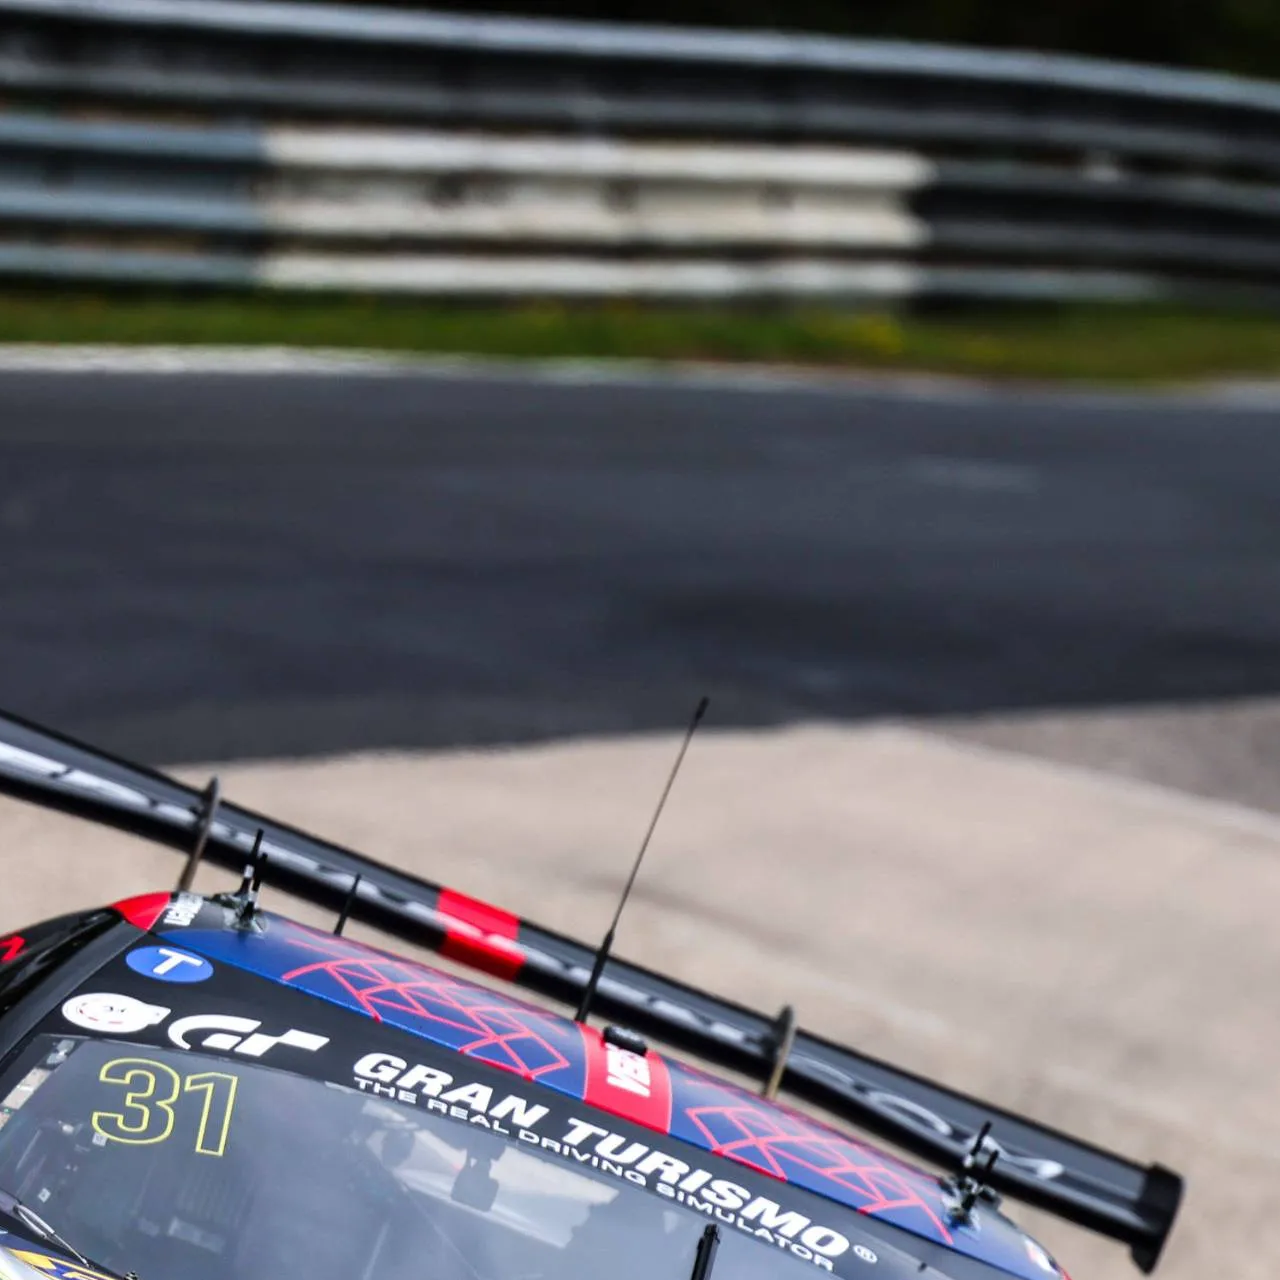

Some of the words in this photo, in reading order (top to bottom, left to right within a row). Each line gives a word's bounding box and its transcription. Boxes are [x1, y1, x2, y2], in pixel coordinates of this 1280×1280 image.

[90, 1057, 238, 1157] 31
[353, 1052, 550, 1128] GRAN
[353, 1076, 417, 1104] THE
[427, 1098, 510, 1134] REAL
[518, 1130, 648, 1187] DRIVING
[656, 1182, 835, 1273] SIMULATOR
